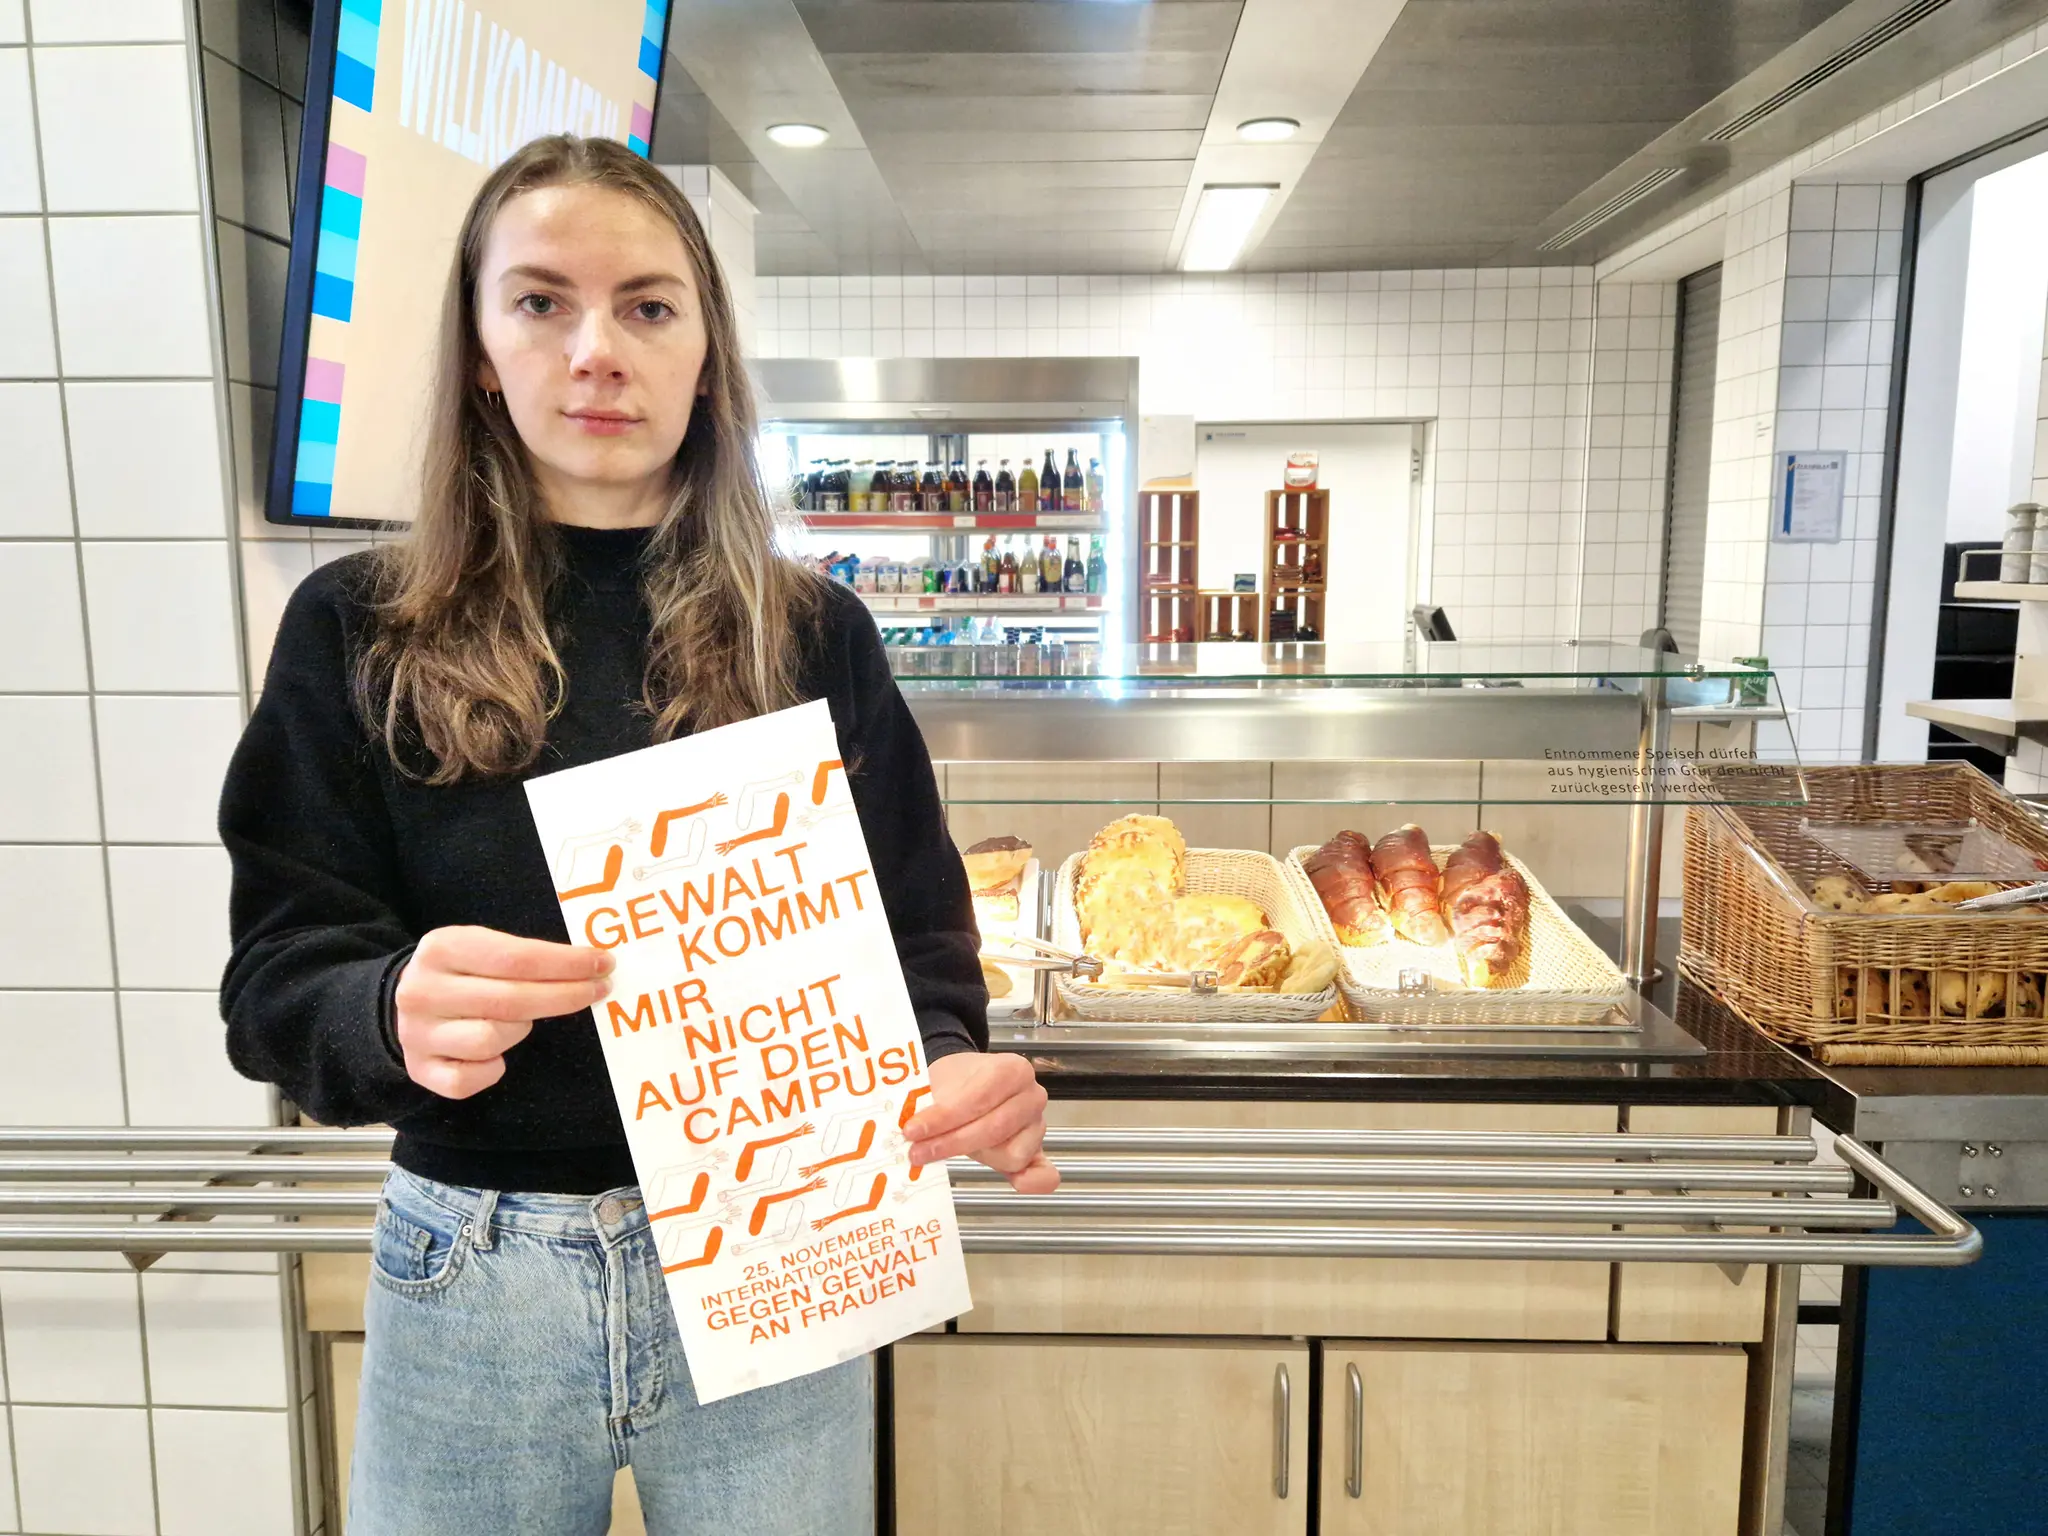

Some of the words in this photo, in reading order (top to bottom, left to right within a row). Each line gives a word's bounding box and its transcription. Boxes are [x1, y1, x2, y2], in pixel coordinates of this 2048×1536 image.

[1544, 748, 1640, 760] Entnommene
[1645, 747, 1704, 761] Speisen
[1709, 747, 1758, 760] dürfen
[1547, 766, 1574, 777] aus
[1578, 764, 1676, 779] hygienischen
[1749, 764, 1786, 777] nicht
[1551, 782, 1654, 796] zurückgestellt
[1660, 782, 1721, 794] werden.
[584, 841, 808, 949] GEWALT
[677, 868, 869, 973] KOMMT
[605, 978, 714, 1038] MIR
[682, 973, 841, 1060] NICHT
[635, 1055, 739, 1121] AUF
[759, 1014, 870, 1081] DEN
[683, 1040, 921, 1145] CAMPUS!
[701, 1235, 895, 1311] INTERNATIONALER
[899, 1218, 942, 1244] TAG
[706, 1284, 812, 1331] GEGEN
[820, 1234, 943, 1293] GEWALT
[742, 1262, 776, 1281] 25.
[781, 1217, 896, 1268] NOVEMBER
[749, 1314, 791, 1345] AN
[801, 1269, 917, 1330] FRAUEN
